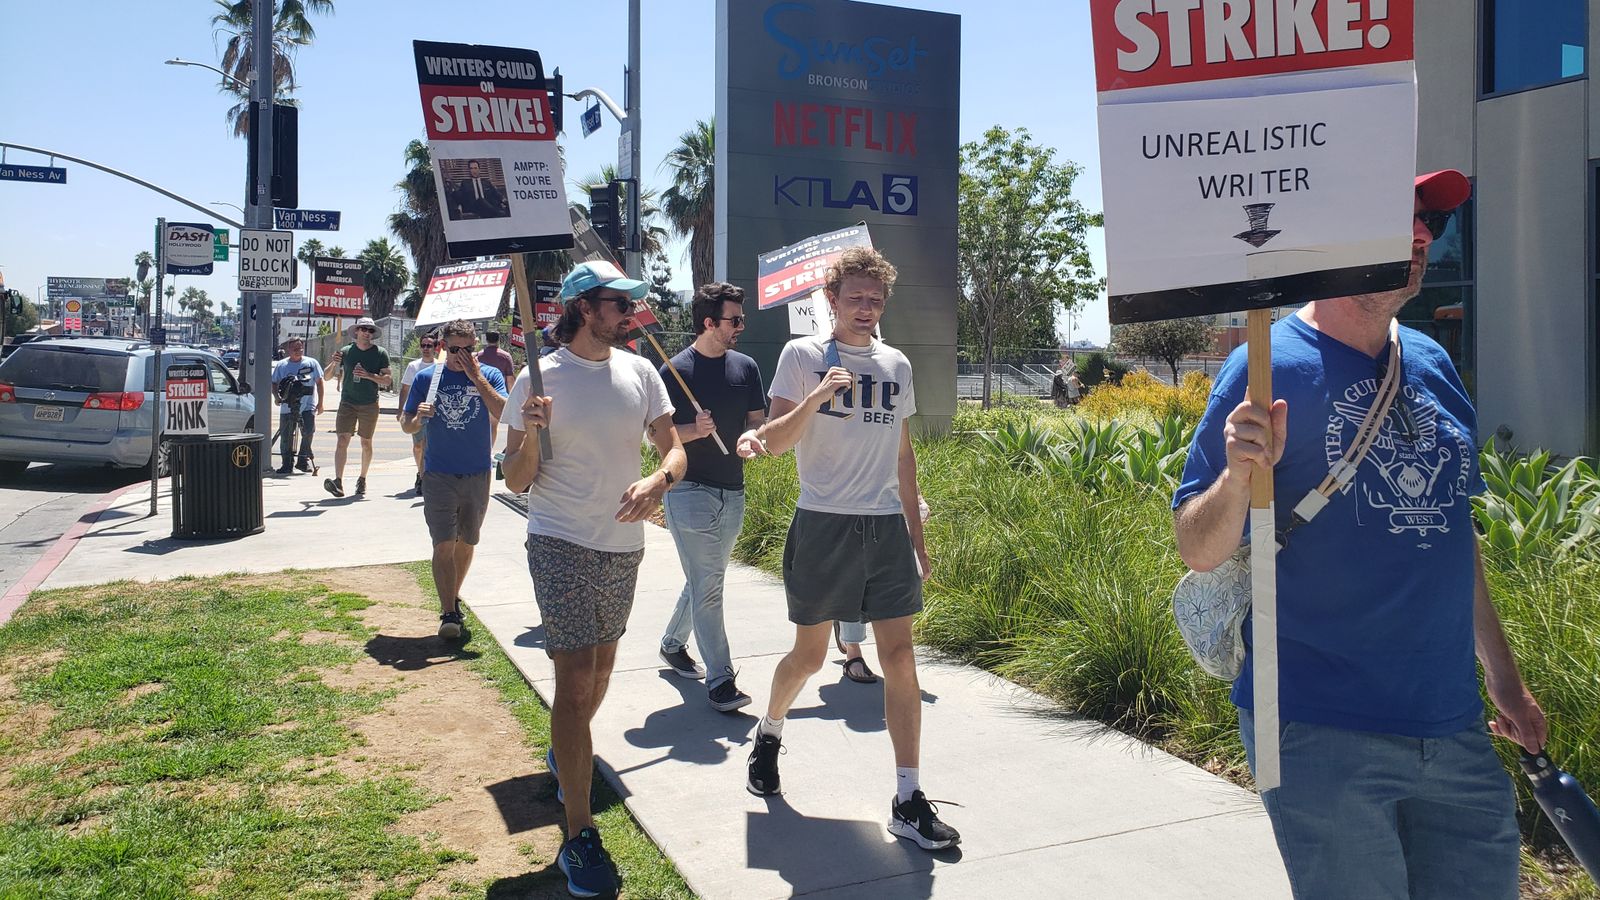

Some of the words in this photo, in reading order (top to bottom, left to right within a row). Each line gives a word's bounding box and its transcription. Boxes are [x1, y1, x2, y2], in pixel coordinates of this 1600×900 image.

[1113, 0, 1391, 72] STRIKE!
[424, 55, 495, 77] WRITERS
[496, 60, 537, 80] GUILD
[480, 81, 495, 93] ON
[808, 74, 868, 90] BRONSON
[431, 96, 547, 134] STRIKE!
[774, 100, 918, 158] NETFLIX
[513, 161, 549, 172] AMPTP:
[18, 169, 45, 179] Ness
[48, 171, 61, 180] Av
[516, 176, 552, 186] YOU'RE
[513, 189, 558, 200] TOASTED
[278, 210, 297, 221] Van
[301, 211, 327, 222] Ness
[278, 221, 295, 229] 1400
[298, 221, 303, 229] N
[170, 231, 210, 242] DASH
[242, 238, 259, 251] DO
[266, 239, 290, 252] NOT
[765, 239, 820, 264] WRITERS
[822, 229, 860, 242] GUILD
[805, 245, 818, 253] OF
[784, 245, 842, 268] AMERICA
[241, 258, 290, 272] BLOCK
[317, 261, 343, 269] WRITERS
[344, 262, 362, 270] GUILD
[439, 262, 479, 275] WRITERS
[480, 260, 508, 270] GUILD
[803, 258, 828, 270] ON
[326, 275, 352, 283] AMERICA
[432, 273, 503, 292] STRIKE!
[764, 266, 825, 298] STRI
[316, 295, 362, 310] STRIKE!
[168, 383, 205, 397] STRIKE!
[167, 400, 207, 431] HONK
[863, 412, 895, 425] BEER
[1404, 515, 1434, 525] WEST
